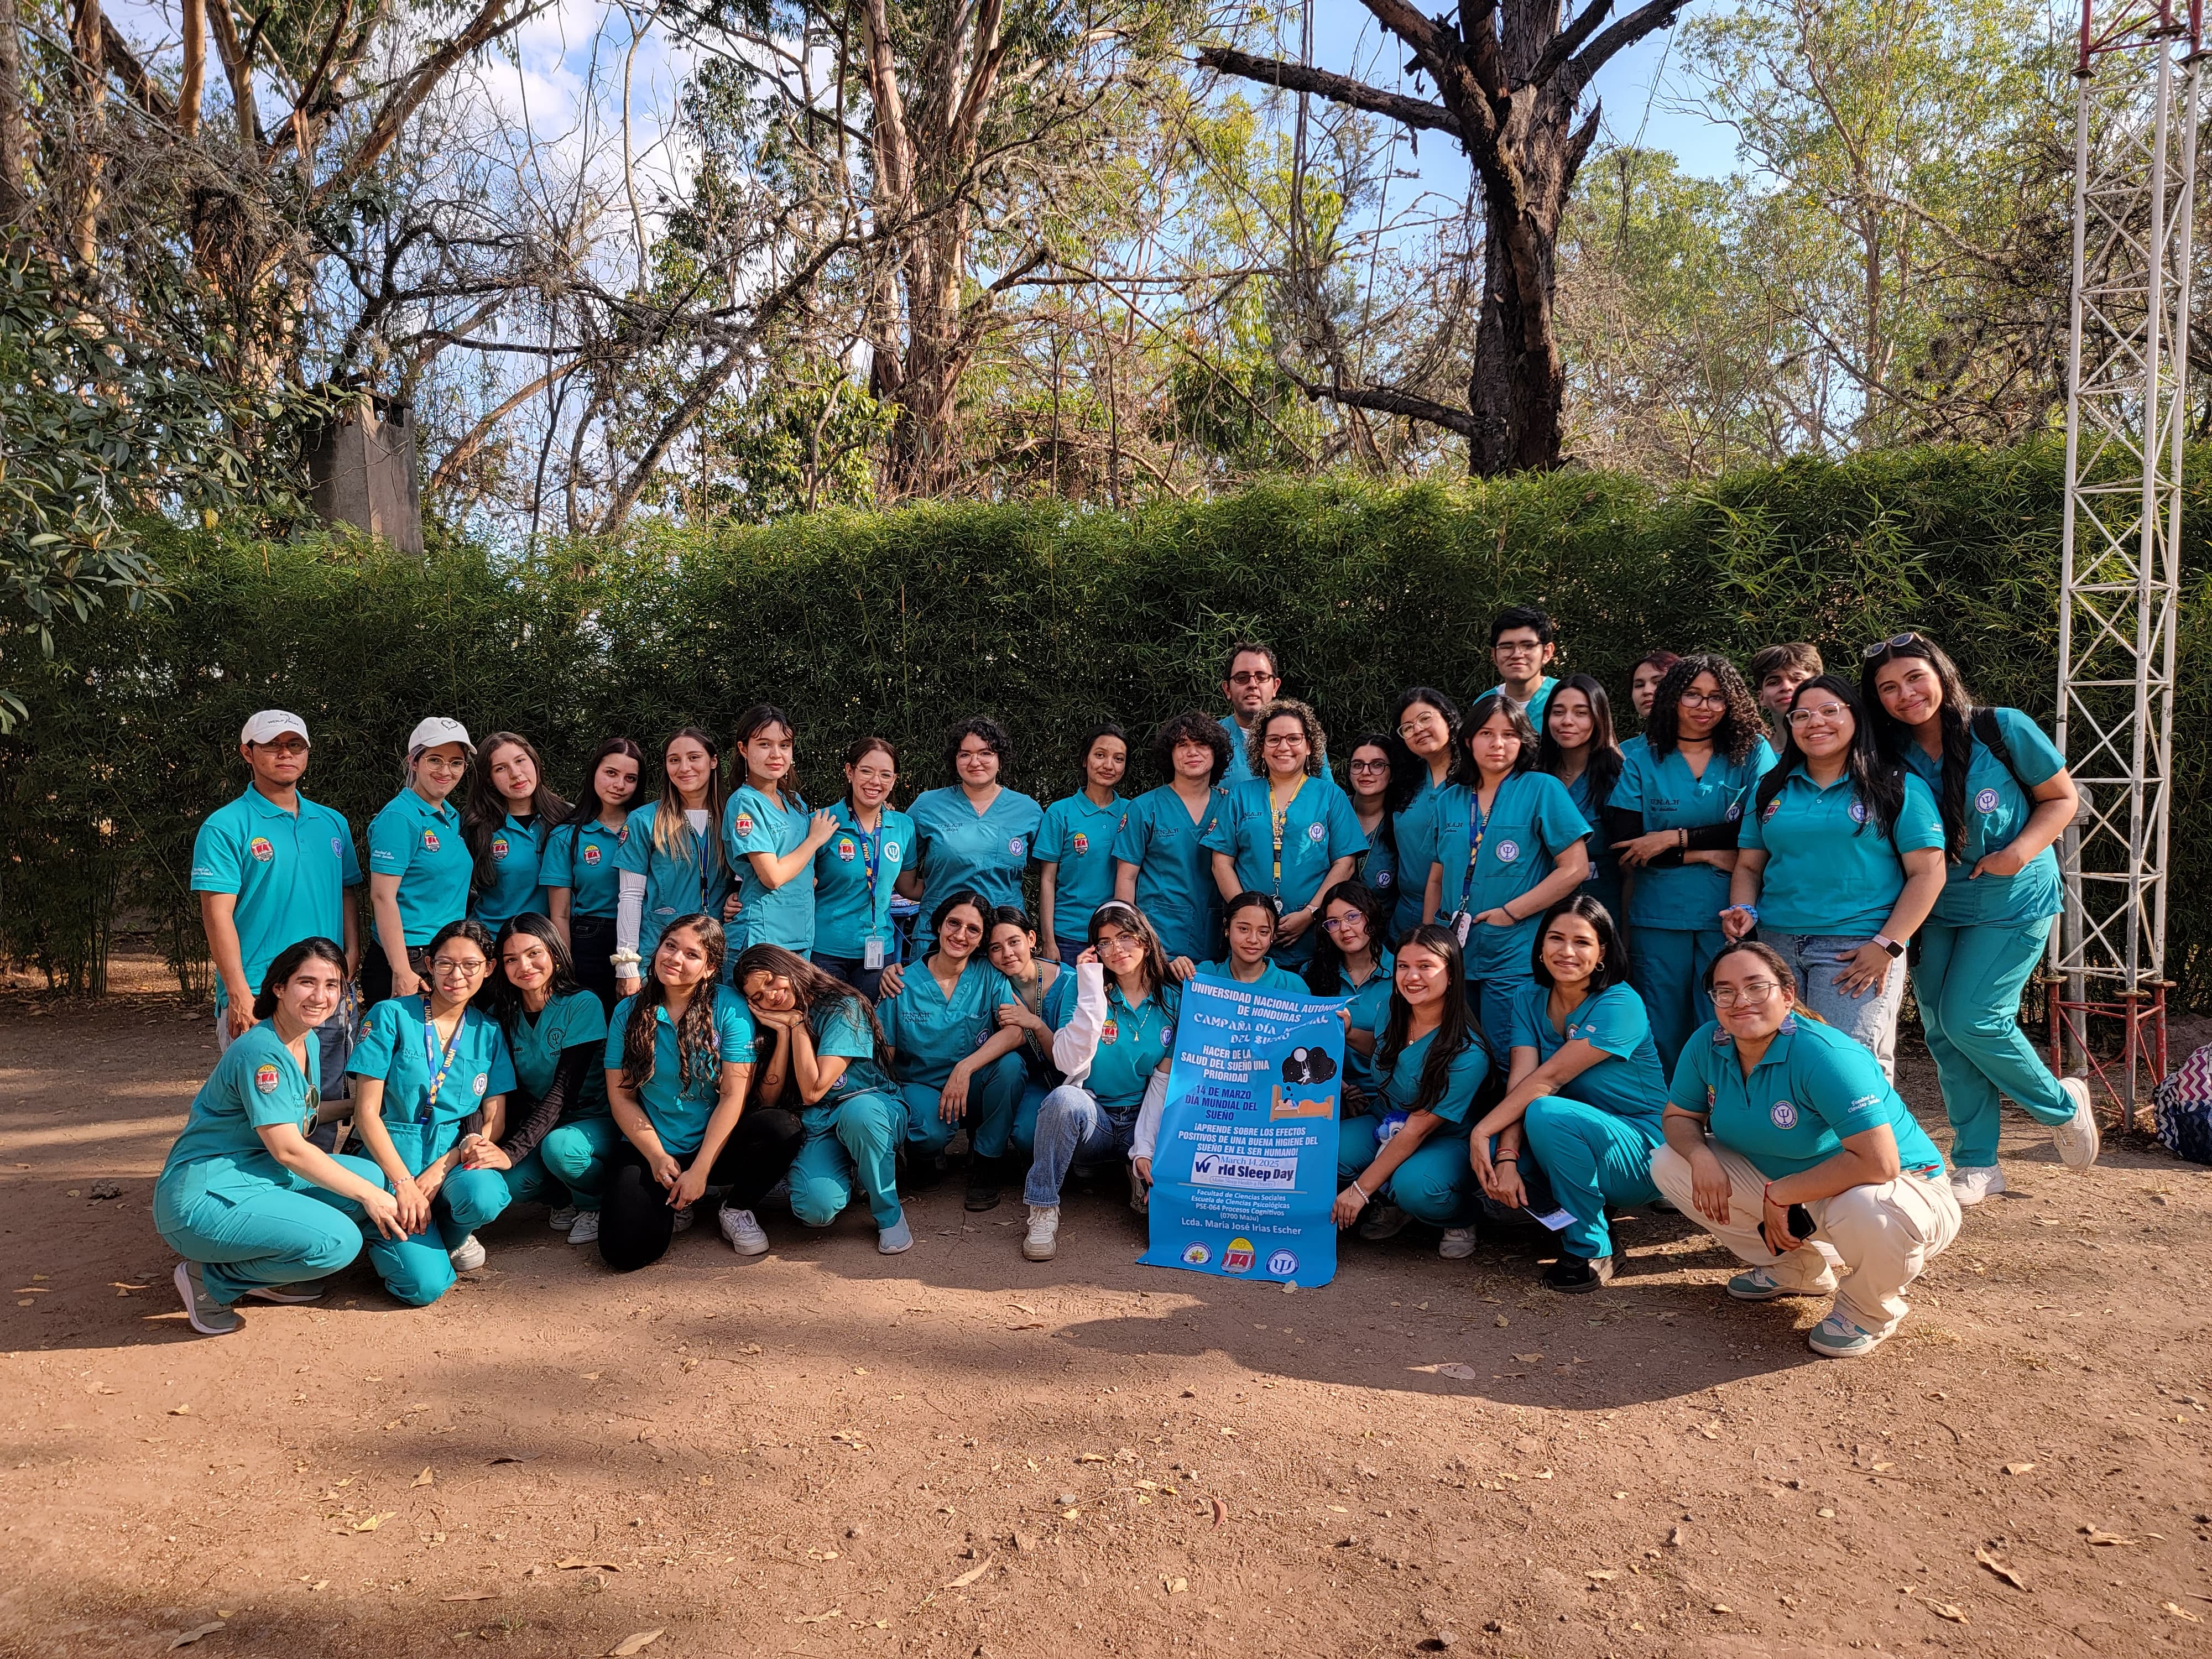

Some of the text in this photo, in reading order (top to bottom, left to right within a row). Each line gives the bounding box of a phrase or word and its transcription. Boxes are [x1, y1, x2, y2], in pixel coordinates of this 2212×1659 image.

[862, 843, 870, 861] UNAH
[1191, 982, 1251, 1004] UNIVERSIDAD
[1253, 995, 1299, 1013] NACIONAL
[424, 1005, 433, 1026] UNAH
[1237, 1004, 1301, 1023] DE HONDURAS
[1193, 1013, 1251, 1031] CAMPAÑA
[1255, 1023, 1276, 1035] DÍA
[1230, 1034, 1251, 1044] DEL
[443, 1048, 456, 1068] UNAH
[1203, 1045, 1251, 1060] HACER DE LA
[1181, 1052, 1270, 1071] SALUD DEL SUEÑO UNA
[1203, 1069, 1248, 1083] PRIORIDAD
[1196, 1085, 1251, 1099] 14 DE MARZO
[1185, 1093, 1258, 1111] DÍA MUNDIAL DEL
[1206, 1109, 1234, 1120] SUEÑO
[1194, 1123, 1306, 1136] ¡APRENDE SOBRE LOS EFECTOS
[1178, 1130, 1318, 1146] POSITIVOS DE UNA BUENA HIGIENE DEL
[1197, 1142, 1222, 1152] SUEÑO
[1224, 1145, 1235, 1154] EN
[1247, 1147, 1262, 1156] SER
[1264, 1147, 1298, 1156] HUMANO!
[1220, 1156, 1246, 1165] March
[1237, 1165, 1271, 1181] Sleep
[1273, 1168, 1295, 1181] Day
[1197, 1189, 1224, 1197] Facultad
[1251, 1208, 1285, 1216] Cognitivos
[1253, 1201, 1290, 1209] Psicológicas
[1181, 1217, 1302, 1235] Lcda. María José Irias Escher
